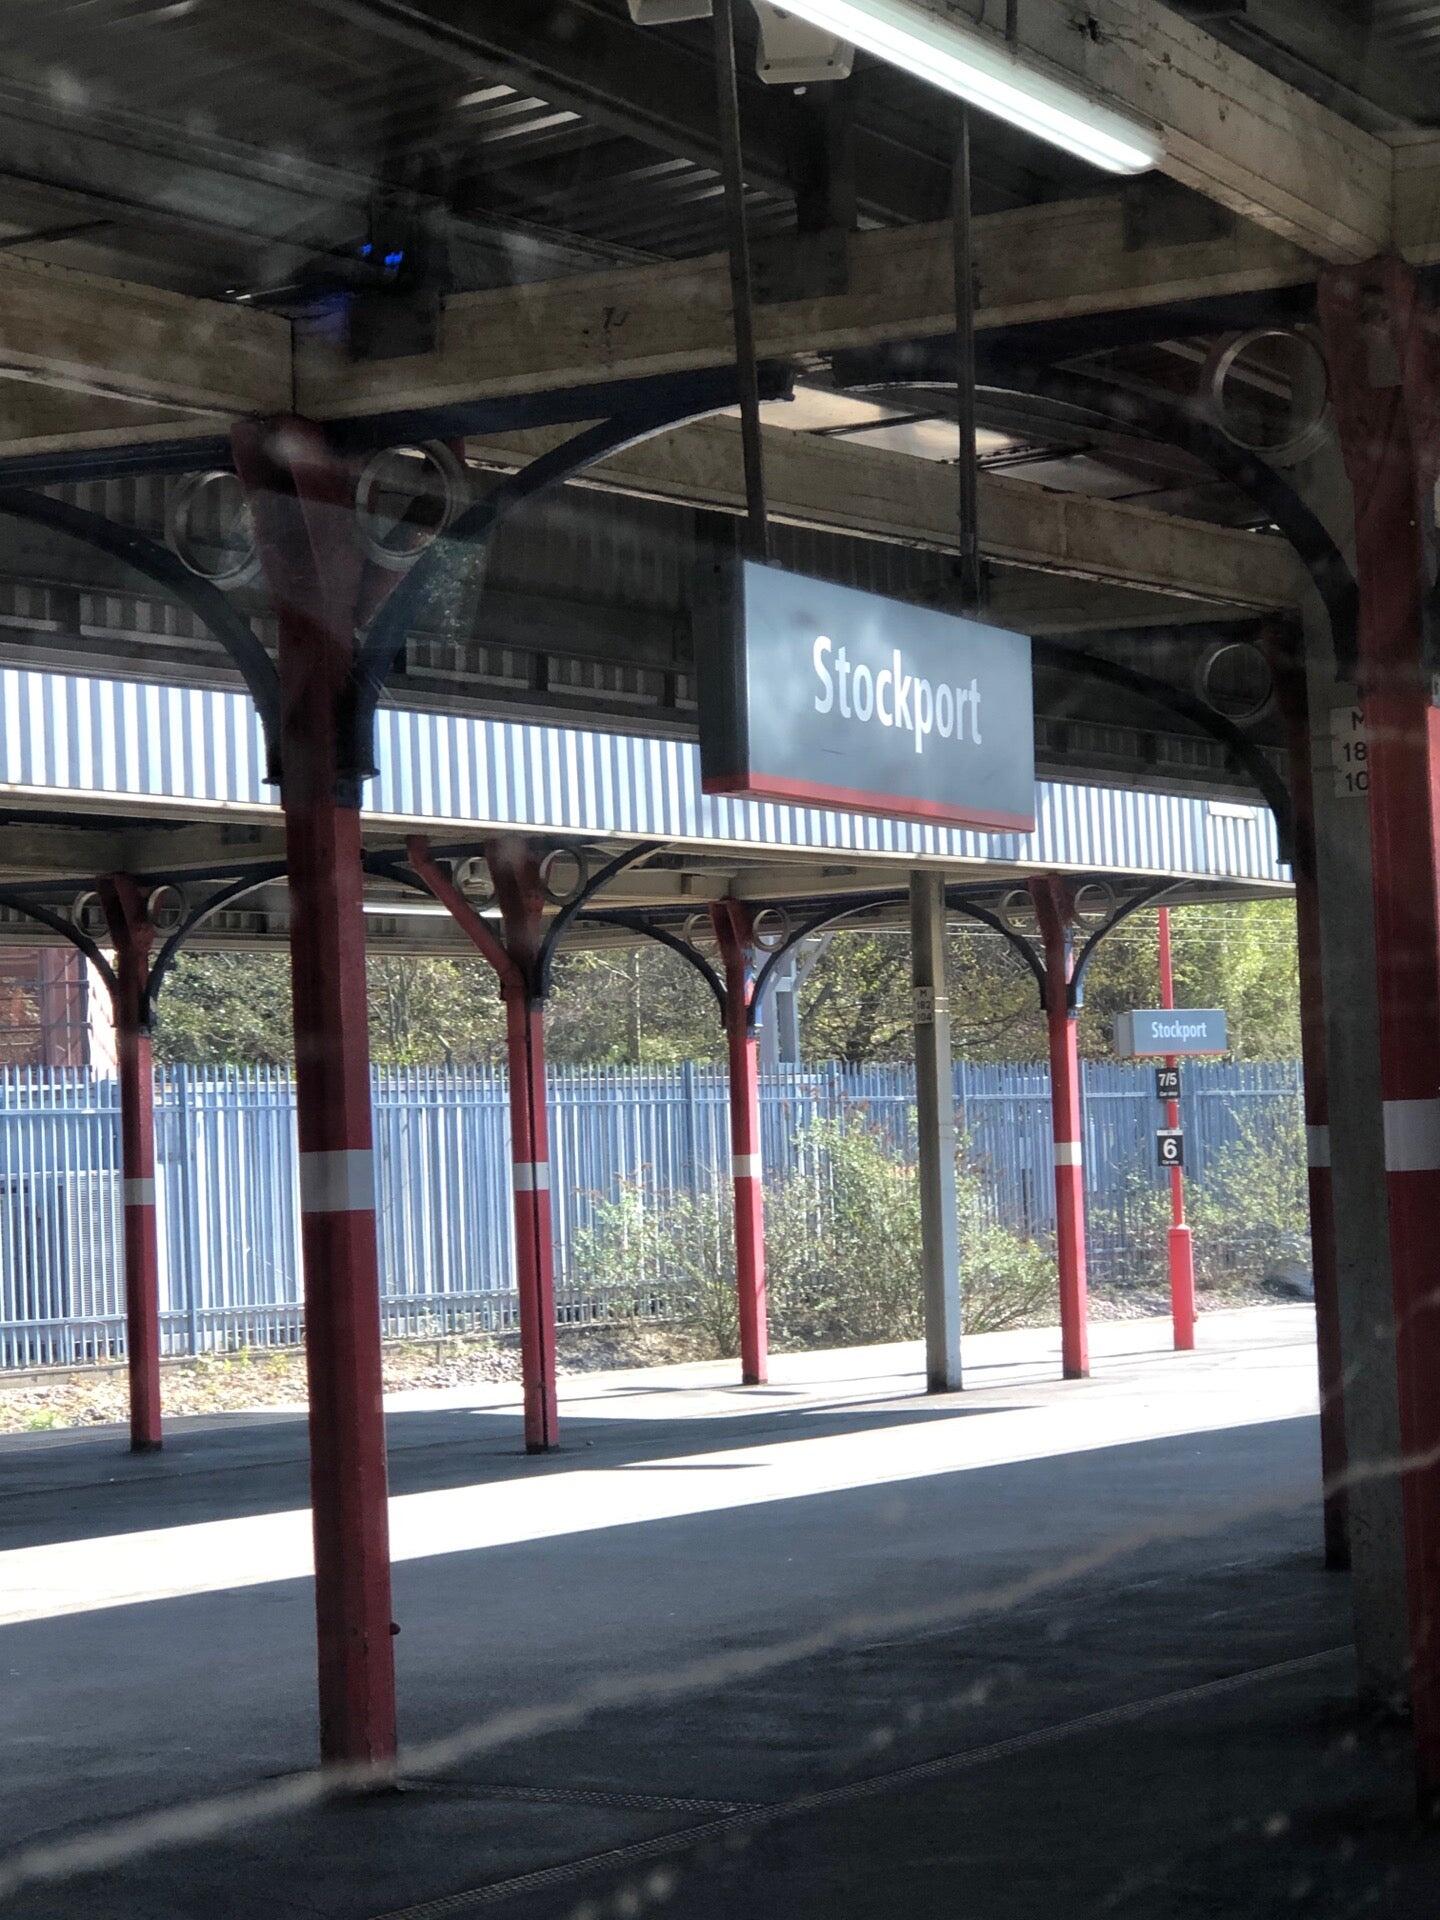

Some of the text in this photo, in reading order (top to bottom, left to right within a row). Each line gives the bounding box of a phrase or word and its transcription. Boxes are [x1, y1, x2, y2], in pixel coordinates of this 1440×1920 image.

[813, 635, 982, 753] Stockport
[1151, 1020, 1207, 1042] Stockport
[1158, 1072, 1178, 1087] 7/5
[1163, 1138, 1178, 1159] 6
